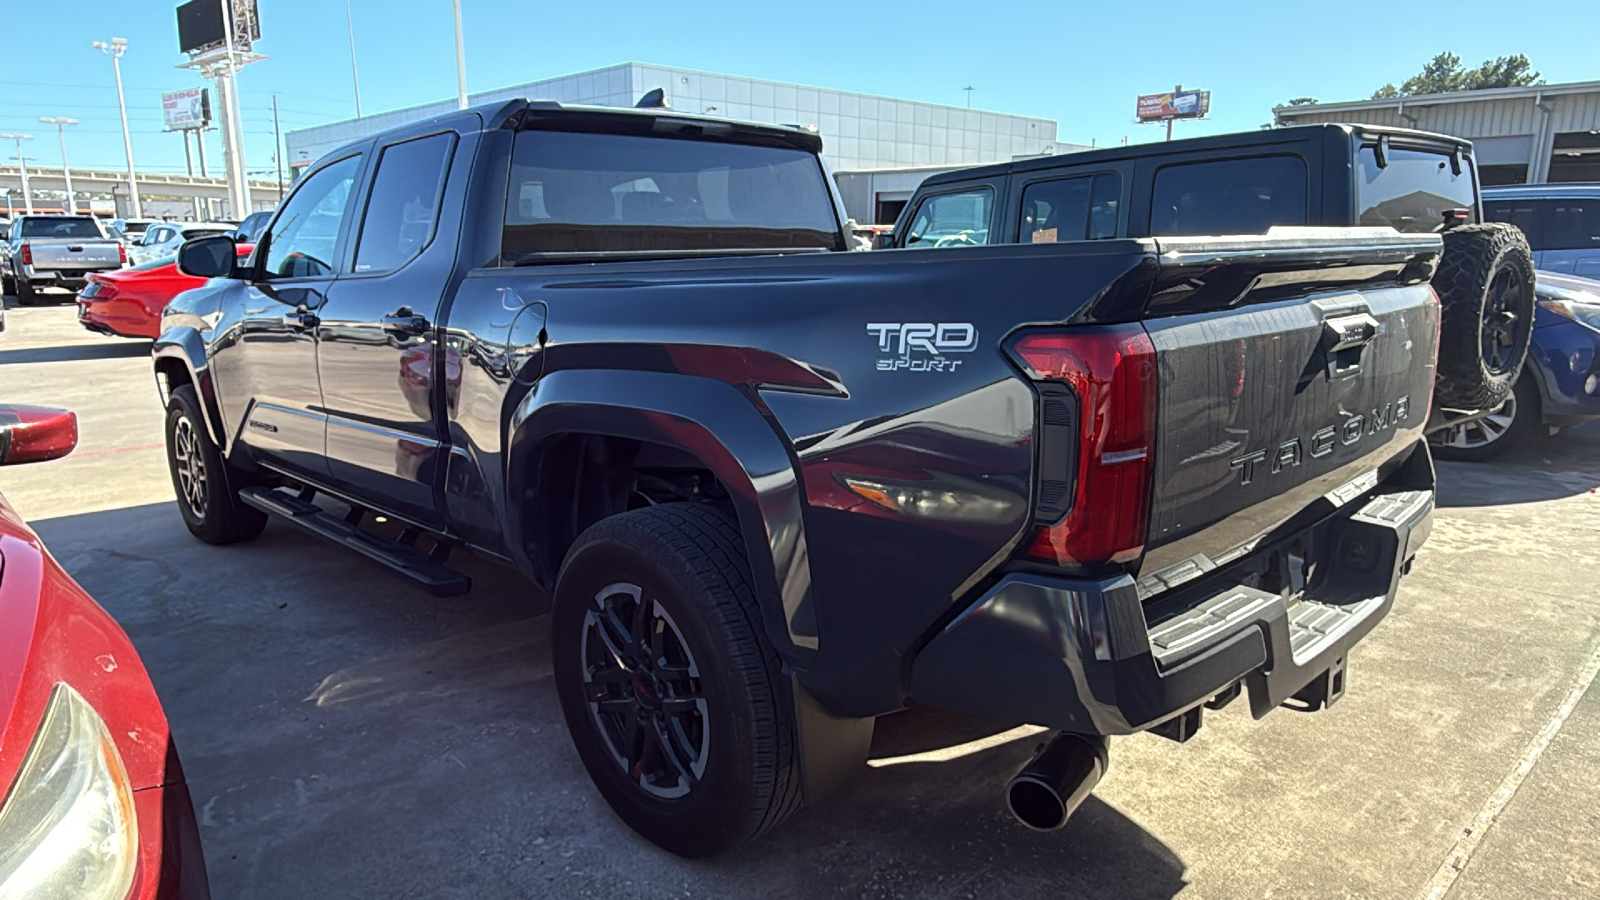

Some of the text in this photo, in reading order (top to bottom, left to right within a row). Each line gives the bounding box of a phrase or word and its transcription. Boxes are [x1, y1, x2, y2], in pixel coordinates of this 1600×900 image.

[866, 322, 979, 358] TRD
[876, 359, 962, 372] SPORT
[1229, 395, 1410, 486] TACOMA
